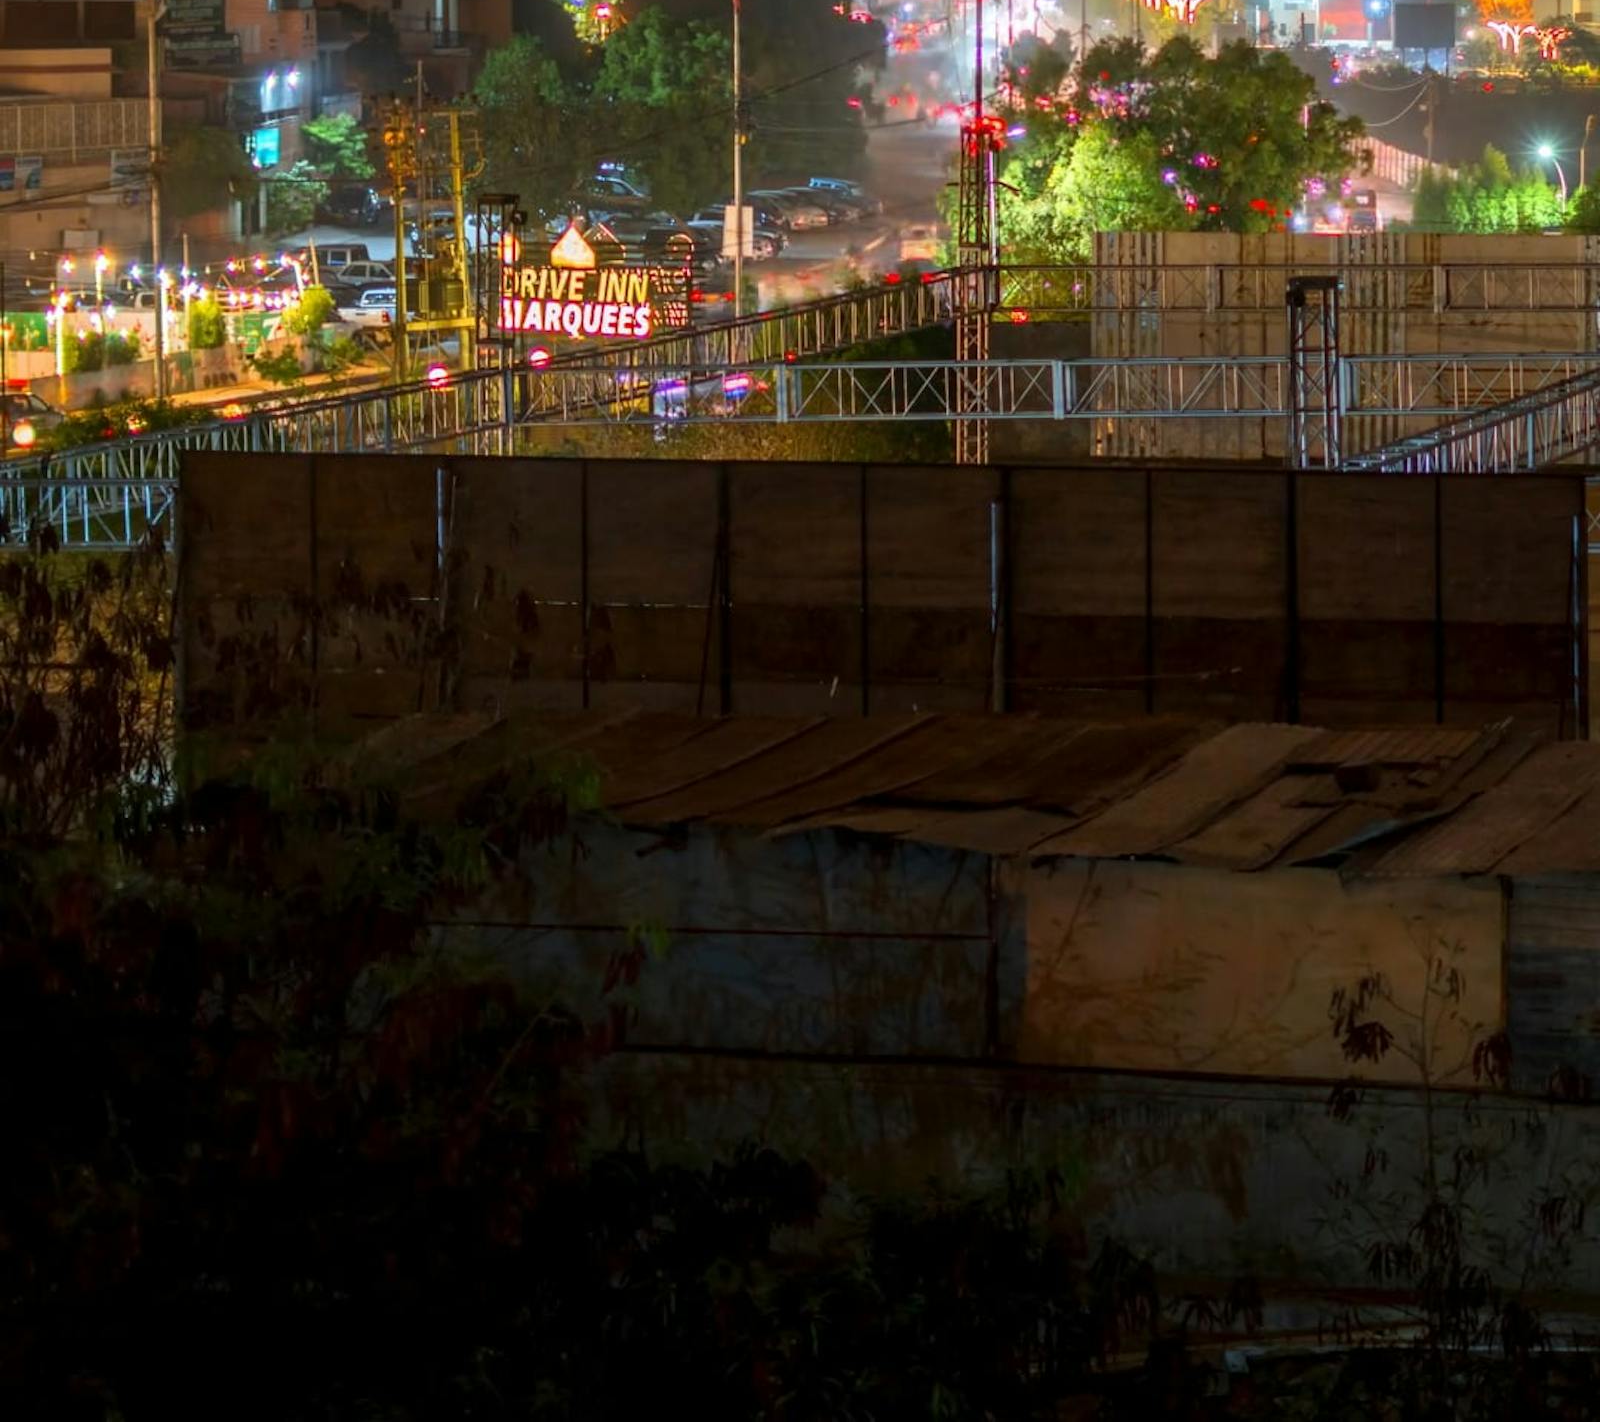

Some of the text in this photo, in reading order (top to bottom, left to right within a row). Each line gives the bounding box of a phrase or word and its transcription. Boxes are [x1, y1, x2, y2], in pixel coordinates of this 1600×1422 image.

[502, 267, 649, 304] DRIVE INN
[497, 298, 651, 337] MARQUEES
